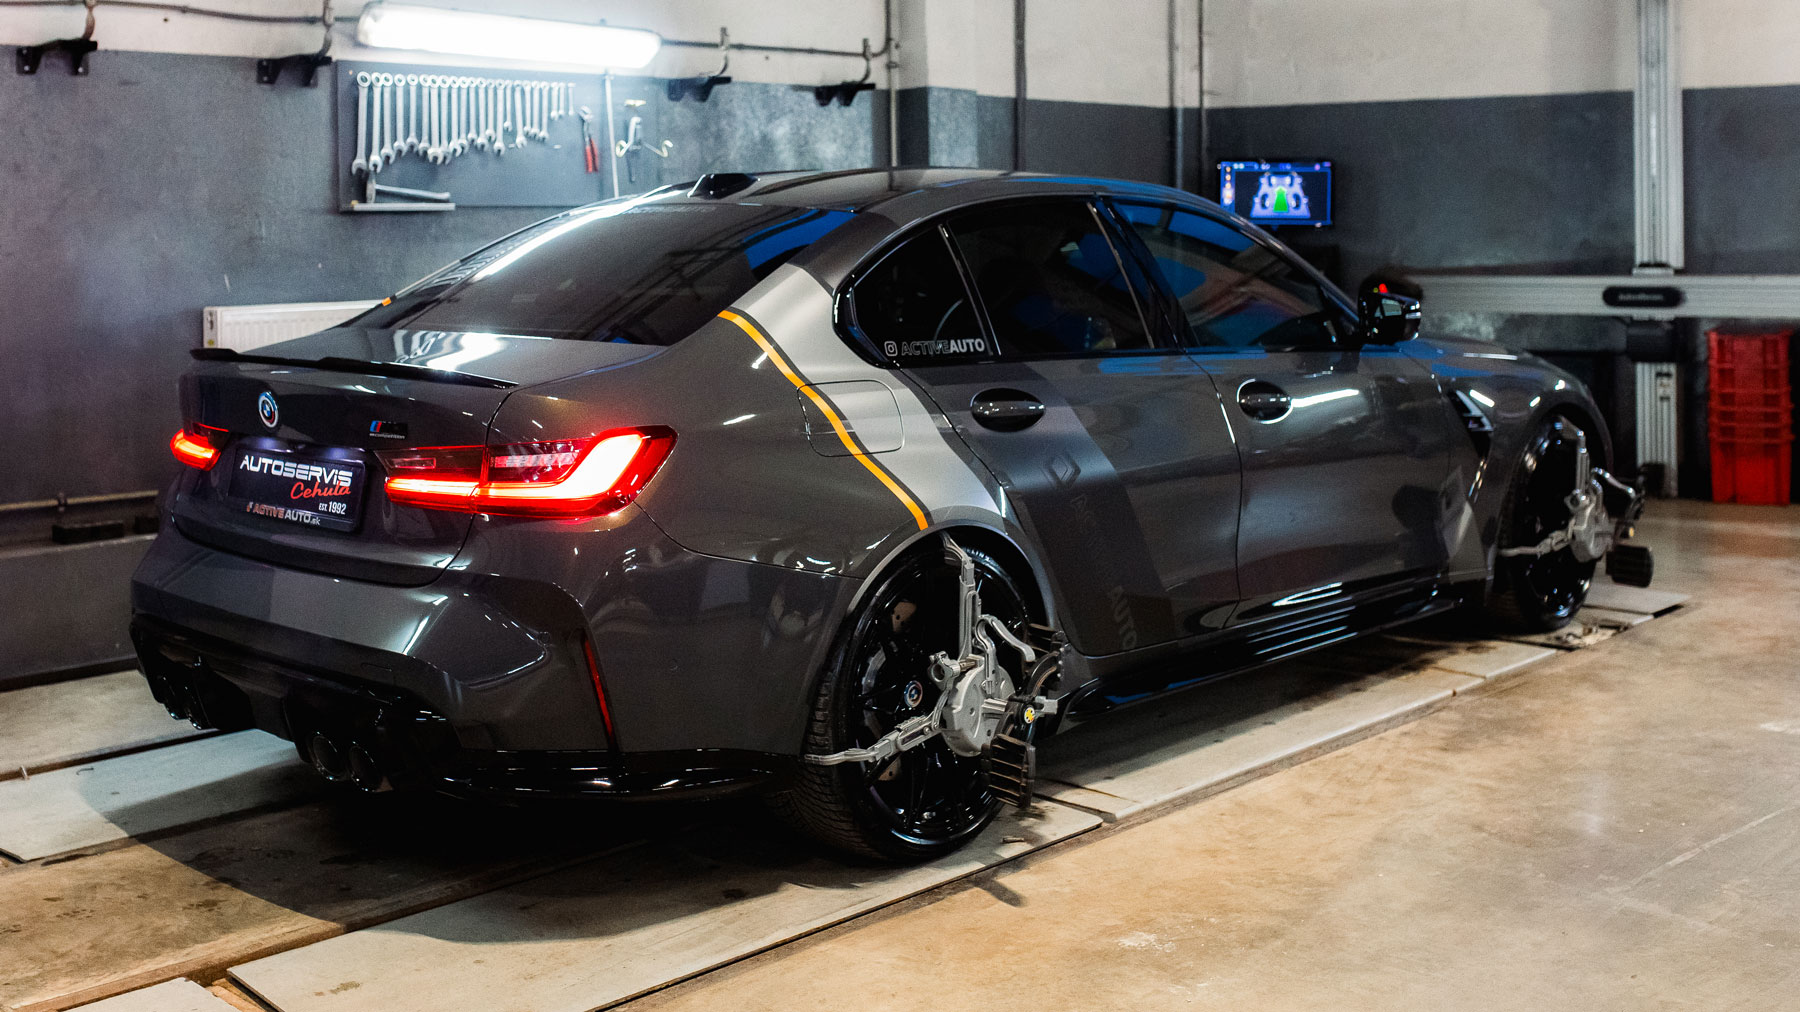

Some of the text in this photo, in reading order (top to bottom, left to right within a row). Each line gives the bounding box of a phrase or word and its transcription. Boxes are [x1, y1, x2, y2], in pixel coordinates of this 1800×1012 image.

[901, 339, 985, 356] ACTIVEAUTO
[290, 480, 352, 499] Cehula
[252, 503, 321, 526] ACTIVEAUTO.sk
[328, 501, 347, 515] 1992
